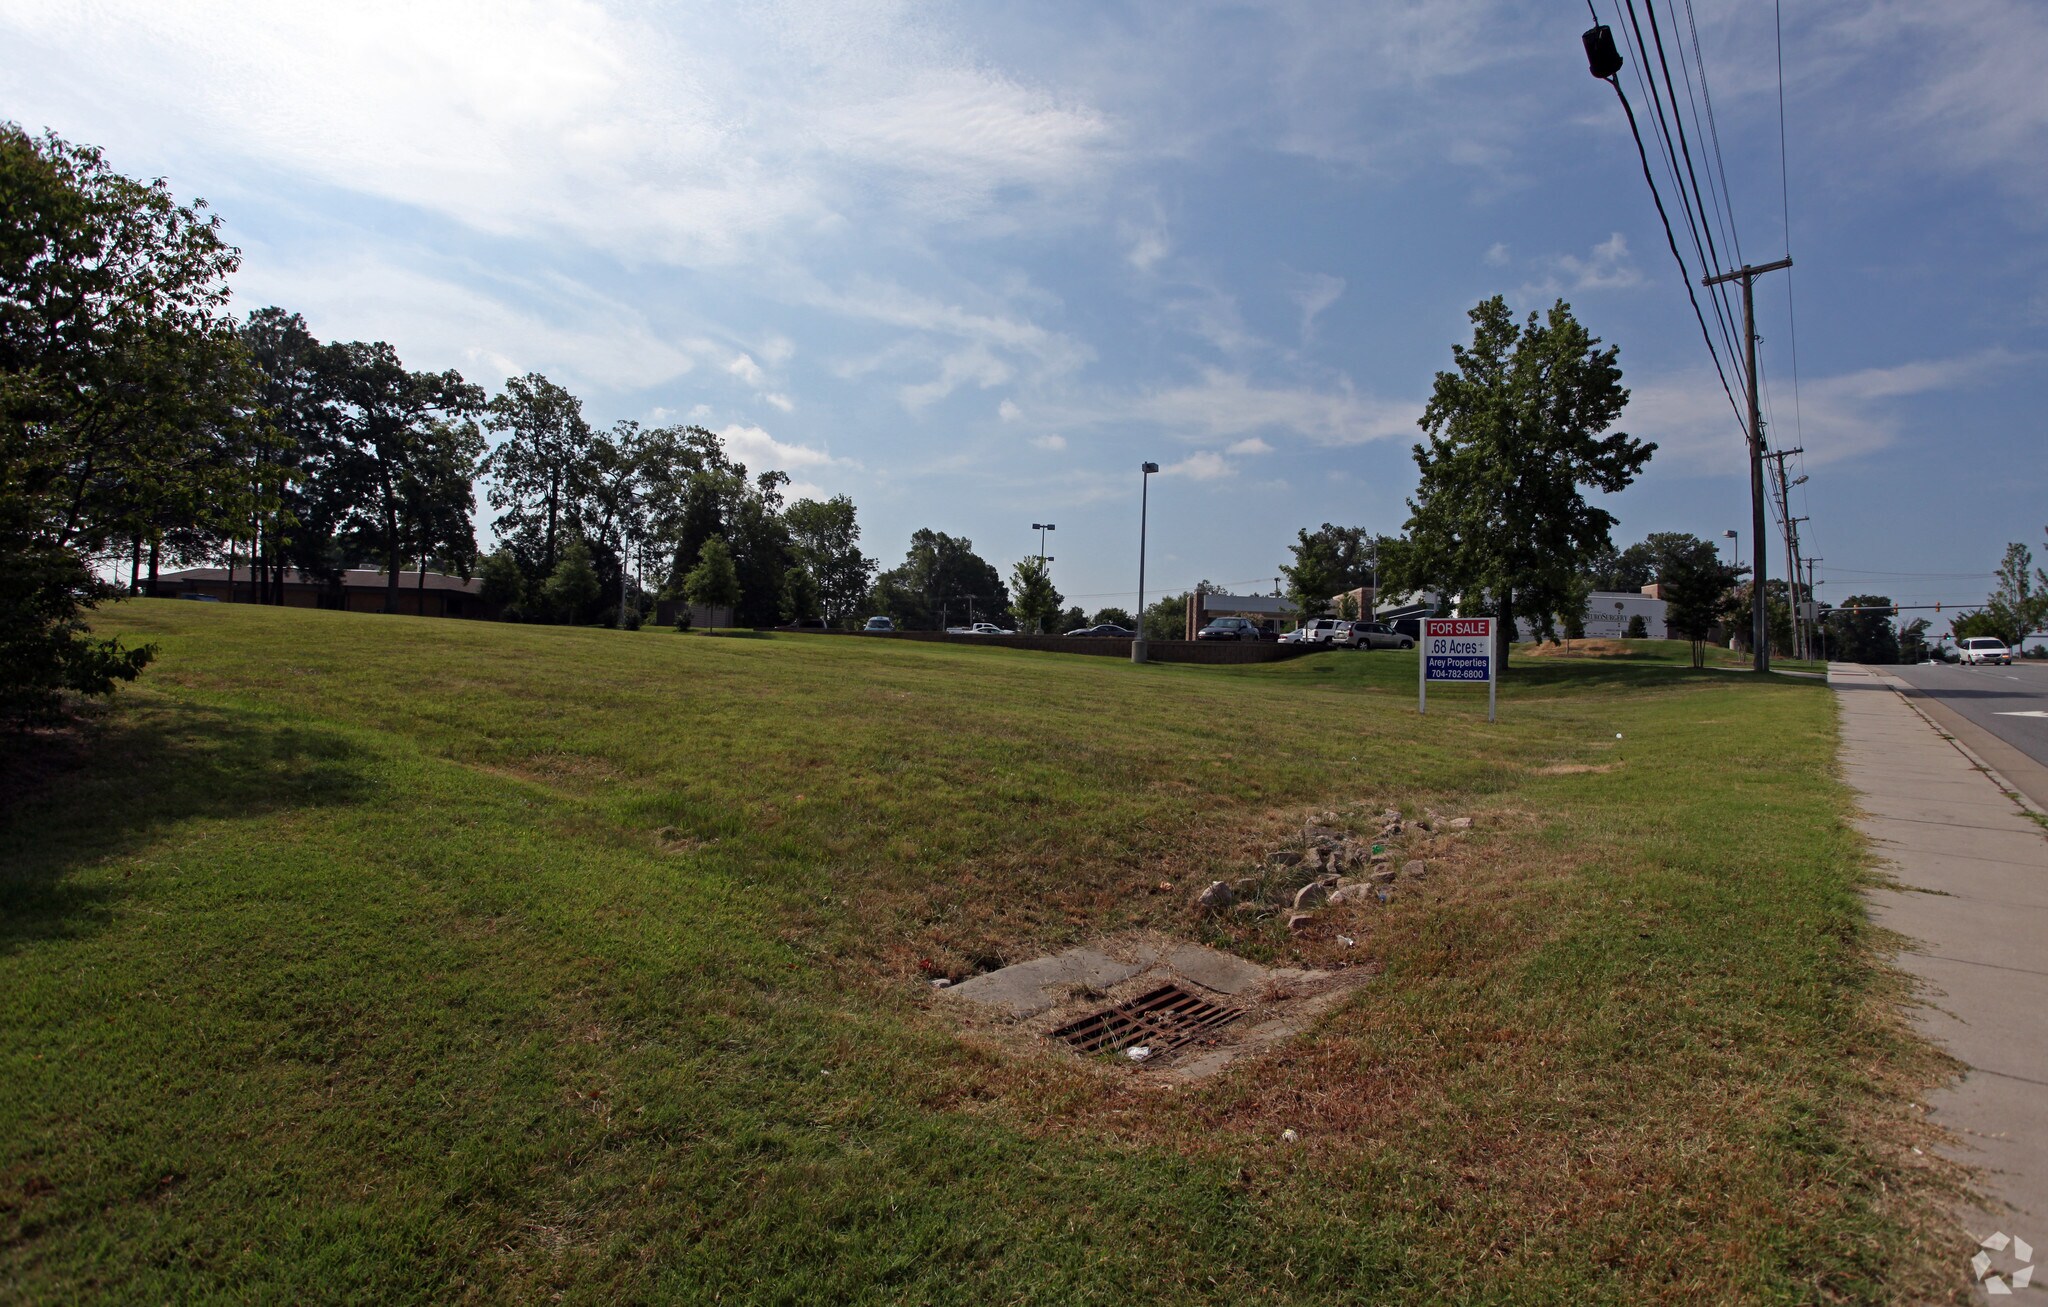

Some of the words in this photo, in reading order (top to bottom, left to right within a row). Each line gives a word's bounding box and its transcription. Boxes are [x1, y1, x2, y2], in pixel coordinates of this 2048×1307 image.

[1430, 622, 1453, 634] FOR
[1455, 622, 1486, 634] SALE
[1431, 639, 1447, 654] .68
[1449, 639, 1477, 654] Acres
[1429, 657, 1446, 668] Arey
[1447, 657, 1487, 668] Properties
[1431, 669, 1484, 679] 704-782-6800
